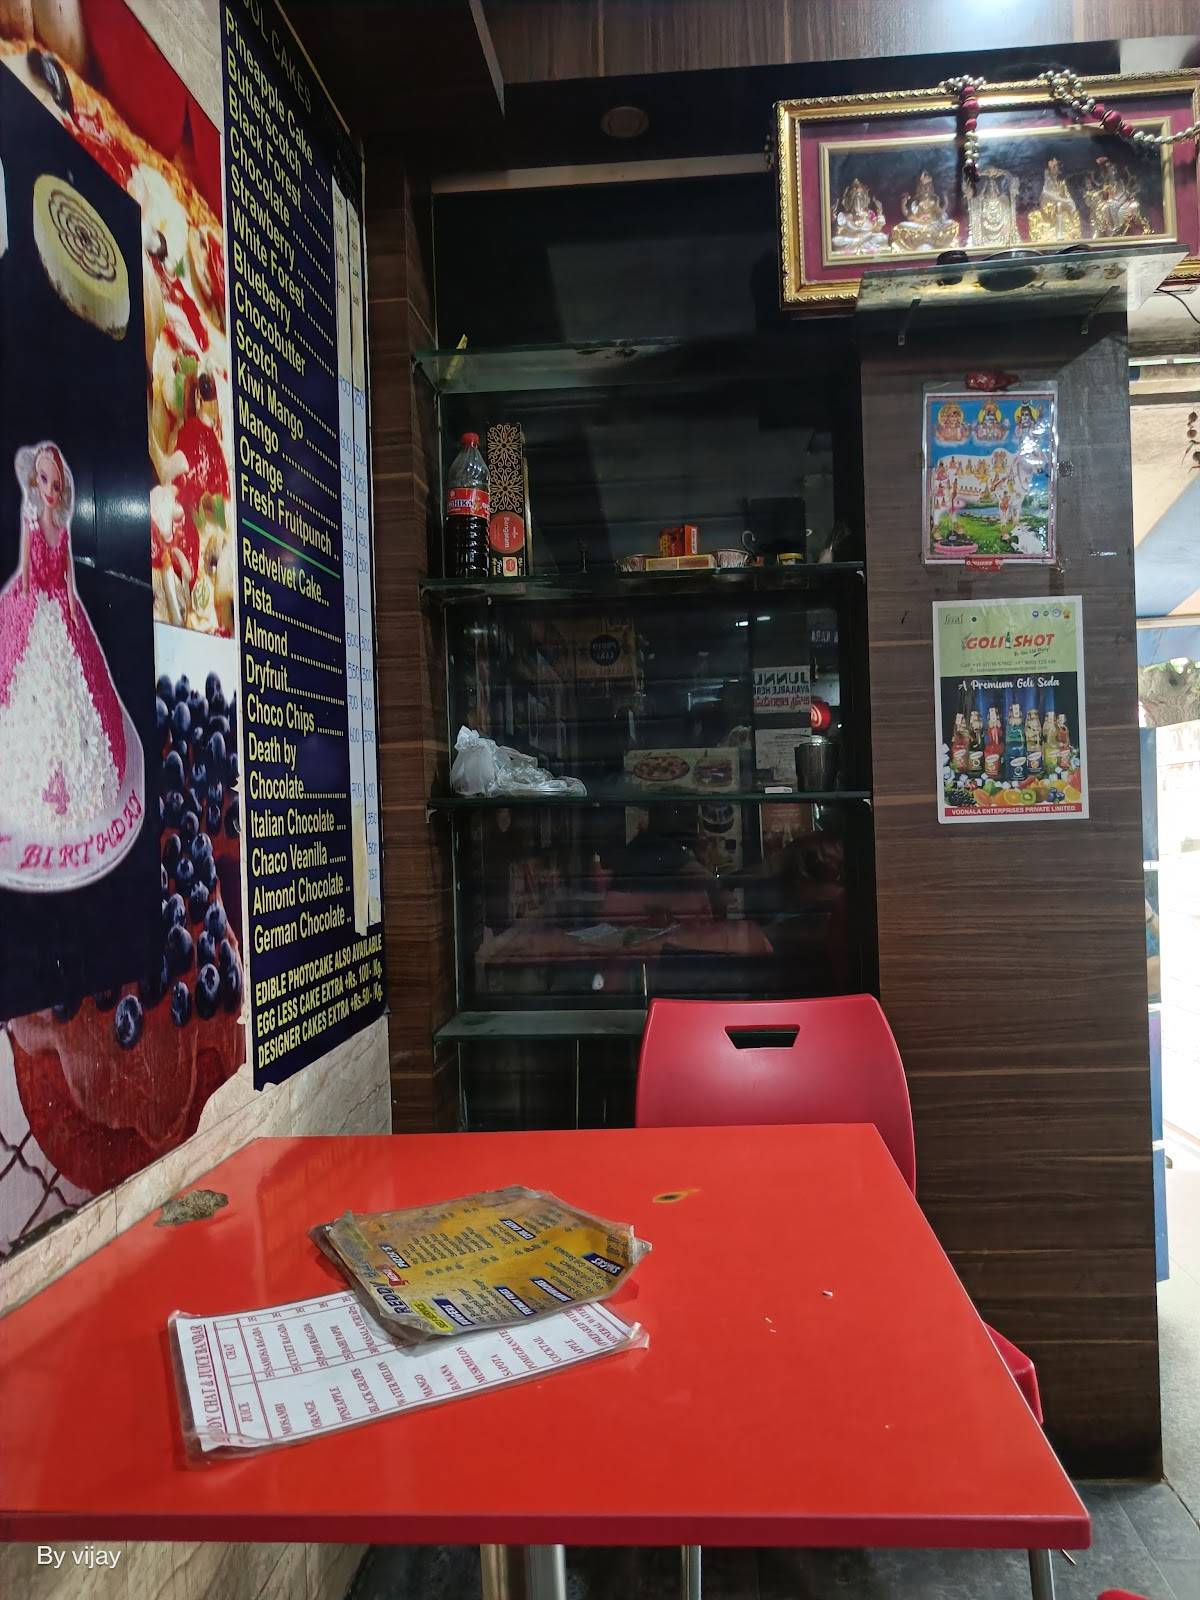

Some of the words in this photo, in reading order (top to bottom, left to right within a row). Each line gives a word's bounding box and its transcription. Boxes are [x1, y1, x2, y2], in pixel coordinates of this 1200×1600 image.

[226, 5, 285, 123] Pineapple
[287, 110, 313, 166] Cake
[227, 45, 302, 181] Butterscotch
[228, 84, 264, 160] Black
[266, 142, 302, 214] Forest
[230, 126, 290, 229] Chocolate
[231, 163, 295, 272] Strawberry
[232, 200, 268, 268] White
[270, 249, 306, 313] Forest
[233, 239, 292, 333] Blueberry
[234, 280, 306, 377] Chocobutter
[236, 319, 279, 384] Scotch
[237, 356, 264, 407] Kiwi
[267, 385, 305, 442] Mango
[239, 395, 280, 455] Mango
[240, 435, 283, 493] Orange
[241, 472, 275, 521] Fresh
[278, 499, 332, 556] Fruitpunch
[242, 536, 298, 592] Redvelvet
[299, 569, 322, 604] Cake
[244, 576, 272, 617] Pista
[245, 616, 288, 658] Almond
[965, 635, 1004, 650] GOLI
[1013, 633, 1055, 648] SHOT
[246, 653, 289, 695] Dryfruit
[970, 679, 1013, 690] Premium
[247, 693, 284, 728] Choco
[286, 702, 316, 738] Chips
[248, 731, 281, 763] Death
[283, 738, 298, 771] by
[249, 770, 305, 799] Chocolate
[250, 808, 285, 839] Italian
[287, 806, 335, 837] Chocolate
[981, 807, 1025, 815] ENTERPRISES
[251, 846, 288, 877] Chaco
[289, 841, 328, 870] Veanilla
[253, 879, 296, 916] Almond
[298, 871, 344, 905] Chocolate
[254, 920, 297, 954] German
[299, 903, 345, 939] Chocolate
[256, 972, 287, 1007] EDIBLE
[288, 953, 333, 991] PHOTOCAKE
[334, 946, 351, 970] ALSO
[352, 933, 382, 962] AVAILABLE
[257, 1008, 276, 1038] EGG
[277, 997, 298, 1027] LESS
[300, 986, 320, 1015] CAKE
[321, 975, 344, 1004] EXTRA
[258, 1024, 301, 1069] DESIGNER
[302, 1010, 327, 1042] CAKES
[328, 997, 350, 1027] EXTRA
[372, 1282, 412, 1314] REDDY
[190, 1324, 208, 1355] BANDAR
[223, 1344, 238, 1360] CHAT
[498, 1327, 538, 1370] POMEGRANATE
[532, 1335, 562, 1363] COCKTAIL
[565, 1339, 585, 1354] APPLE
[196, 1354, 213, 1379] JUICE
[200, 1379, 214, 1387] &
[351, 1368, 370, 1391] GRAPES
[377, 1360, 395, 1383] MELON
[440, 1364, 461, 1391] BANANA
[455, 1346, 488, 1384] MUSKMELON
[491, 1353, 513, 1376] SAPOTA
[202, 1387, 220, 1413] CHAT
[329, 1385, 352, 1421] PINEAPPLE
[361, 1390, 380, 1414] BLACK
[387, 1382, 406, 1407] WATER
[414, 1374, 434, 1398] MANGO
[239, 1401, 253, 1422] JUICE
[274, 1402, 292, 1435] MOSAMBI
[304, 1400, 322, 1430] ORANGE
